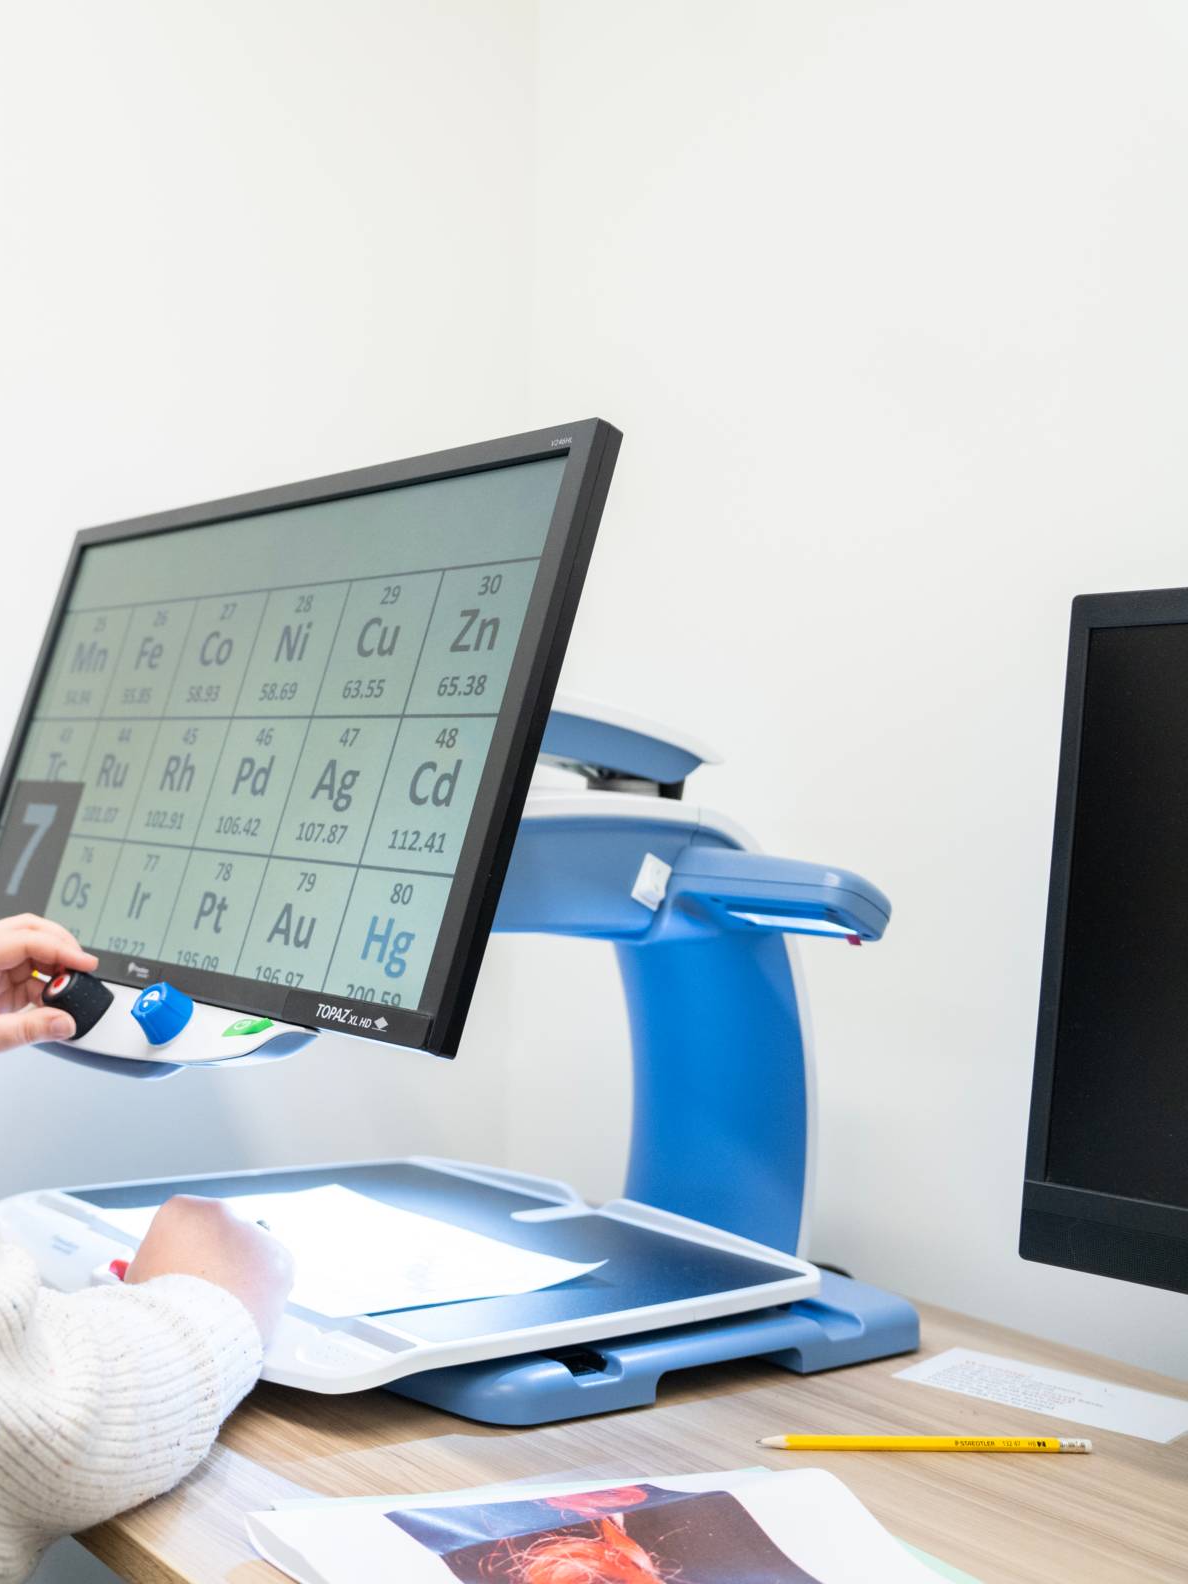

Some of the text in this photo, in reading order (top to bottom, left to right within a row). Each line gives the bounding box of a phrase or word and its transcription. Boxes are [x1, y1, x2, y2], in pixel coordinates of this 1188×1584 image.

[380, 585, 402, 605] 29
[477, 574, 503, 596] 30
[220, 603, 238, 621] 27
[294, 594, 314, 614] 28
[274, 622, 313, 663] Ni
[356, 617, 401, 658] Cu
[449, 608, 501, 653] Zn
[71, 640, 109, 673] Mn
[135, 636, 164, 670] Fe
[199, 631, 234, 667] Co
[185, 685, 221, 703] 58.93
[258, 682, 299, 702] 58.69
[342, 679, 386, 699] 63.55
[436, 675, 488, 697] 65.38
[182, 727, 199, 744] 45
[255, 727, 275, 746] 46
[339, 728, 360, 748] 47
[435, 727, 460, 749] 48
[96, 753, 130, 788] Ru
[159, 753, 196, 792] Rh
[232, 755, 275, 797] Pd
[311, 759, 361, 813] Ag
[409, 759, 463, 808] Cd
[144, 810, 185, 830] 102.91
[215, 815, 261, 837] 106.42
[295, 822, 348, 845] 107.87
[388, 829, 446, 854] 112.41
[6, 803, 59, 896] 7
[143, 853, 161, 873] 77
[214, 862, 233, 882] 78
[61, 872, 92, 910] Os
[296, 871, 317, 893] 79
[390, 883, 414, 905] 80
[127, 881, 152, 920] Ir
[194, 891, 228, 934] Pt
[267, 903, 317, 950] Au
[361, 915, 416, 979] Hg
[316, 1003, 372, 1028] TOPAZ XL HD
